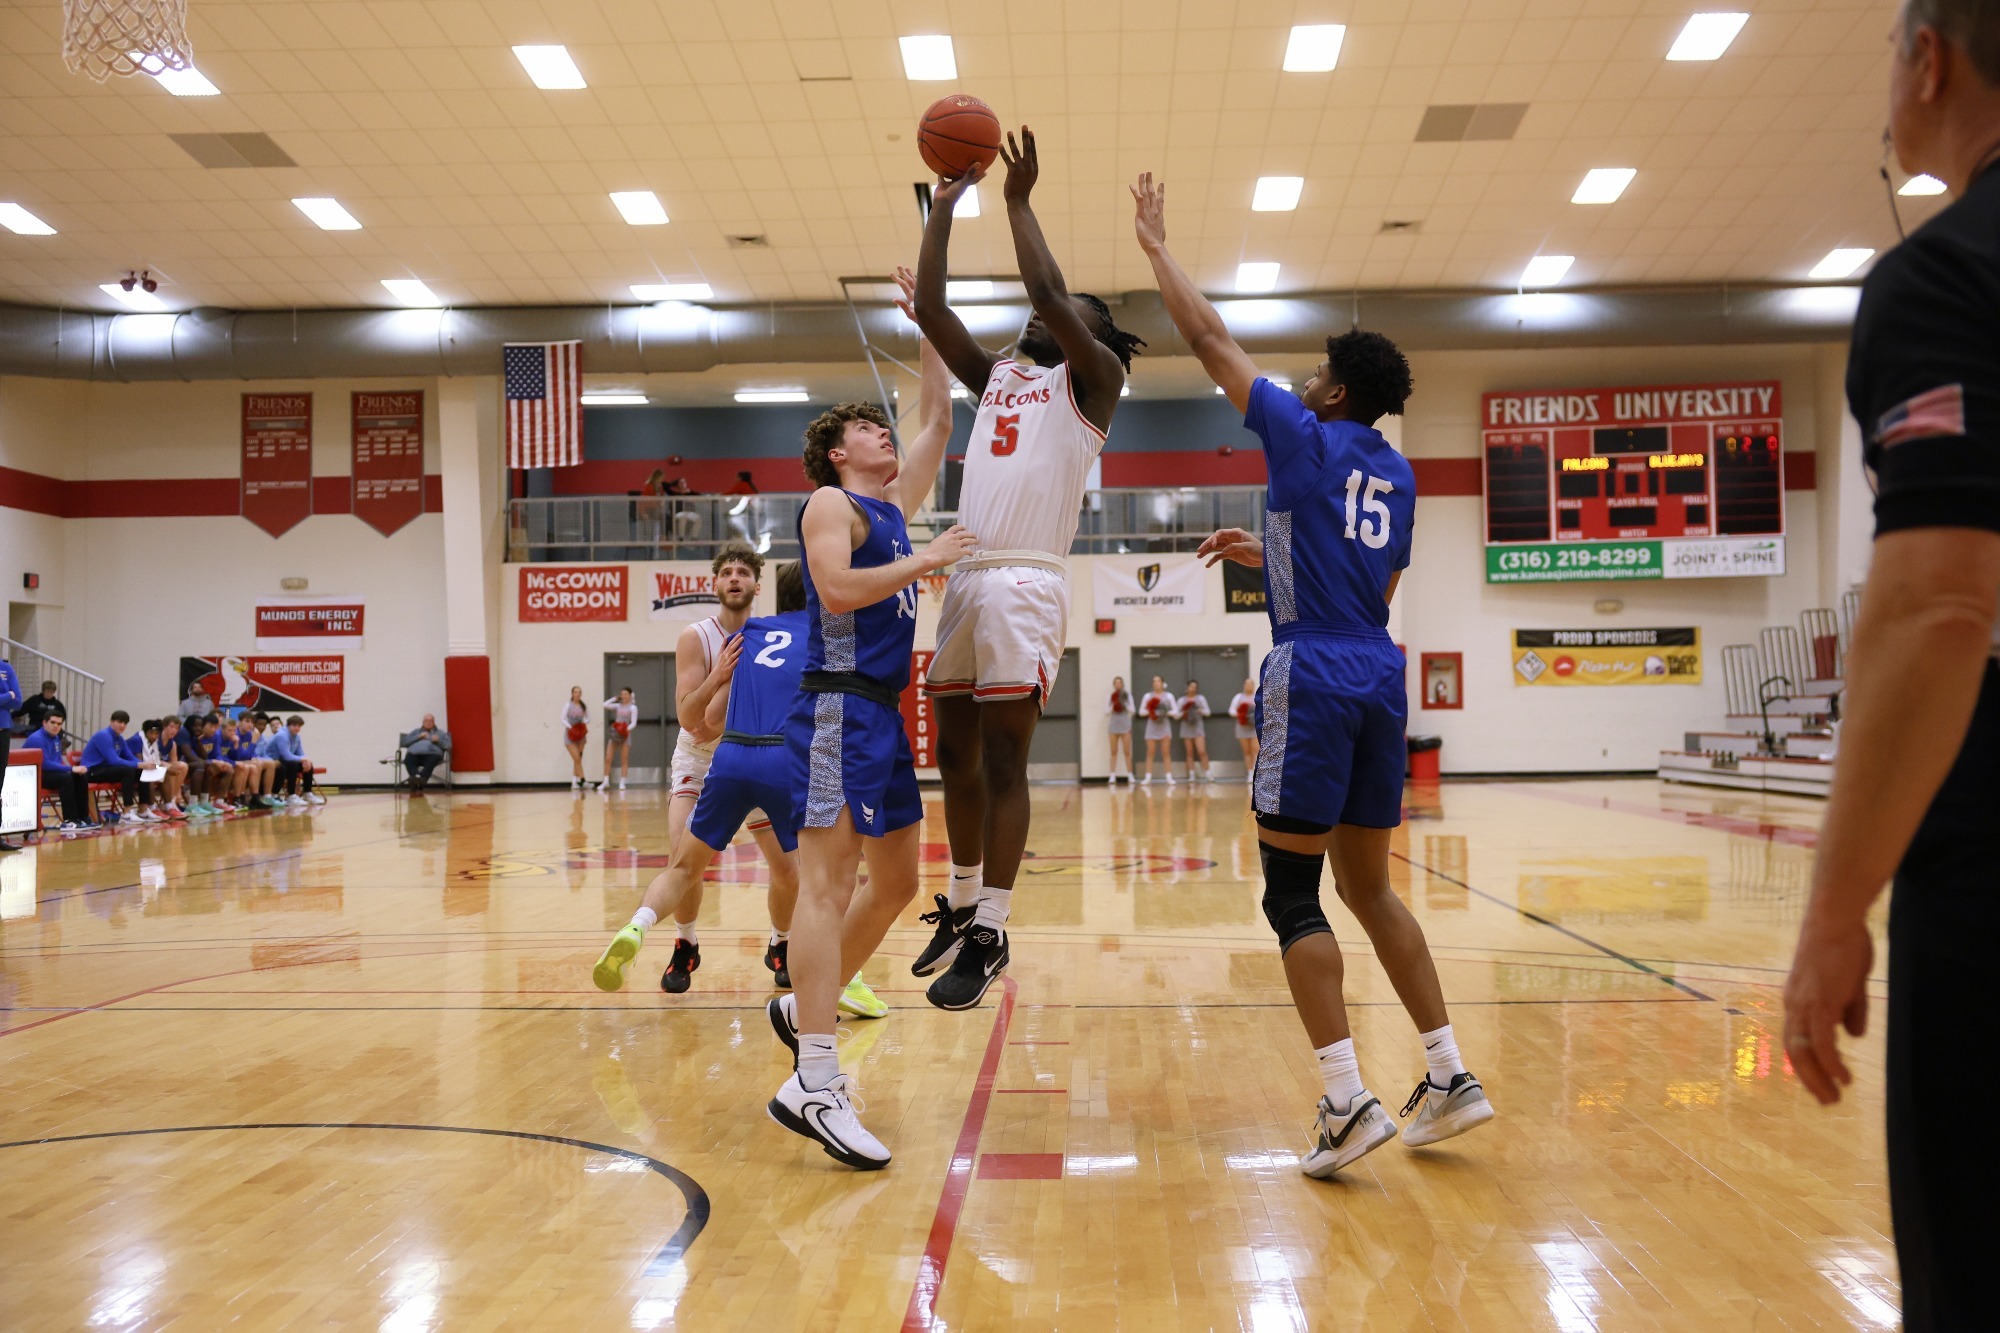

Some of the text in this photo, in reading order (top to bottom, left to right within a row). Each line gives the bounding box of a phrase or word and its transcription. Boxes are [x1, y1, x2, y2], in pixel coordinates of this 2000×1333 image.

[249, 397, 306, 410] FRIENDS
[359, 395, 417, 409] FRIENDS
[1489, 386, 1774, 425] FRIENDS UNIVERSITY
[990, 412, 1020, 457] 5
[1562, 457, 1609, 471] FALCONS
[1649, 453, 1704, 468] BLUEJAYS
[1344, 468, 1394, 549] 15
[1606, 497, 1638, 508] PLAYER
[1499, 547, 1651, 570] (316) 219-8299
[1673, 552, 1716, 566] JOINT
[1733, 551, 1777, 564] SPINE
[527, 571, 620, 589] McCOWN
[1490, 567, 1661, 580] www.kansasjointandspine.com
[527, 591, 620, 608] GORDON
[1113, 595, 1184, 605] WICHITA SPORTS
[308, 609, 359, 620] ENERGY
[327, 621, 356, 631] INC.
[1553, 630, 1657, 645] PROUD SPONSORS
[754, 630, 792, 668] 2
[1667, 654, 1698, 664] TACO
[254, 661, 341, 674] FRIENDSATHLETICS.COM
[281, 674, 341, 685] @FRIENDSFALCONS
[916, 654, 929, 766] FALCONS
